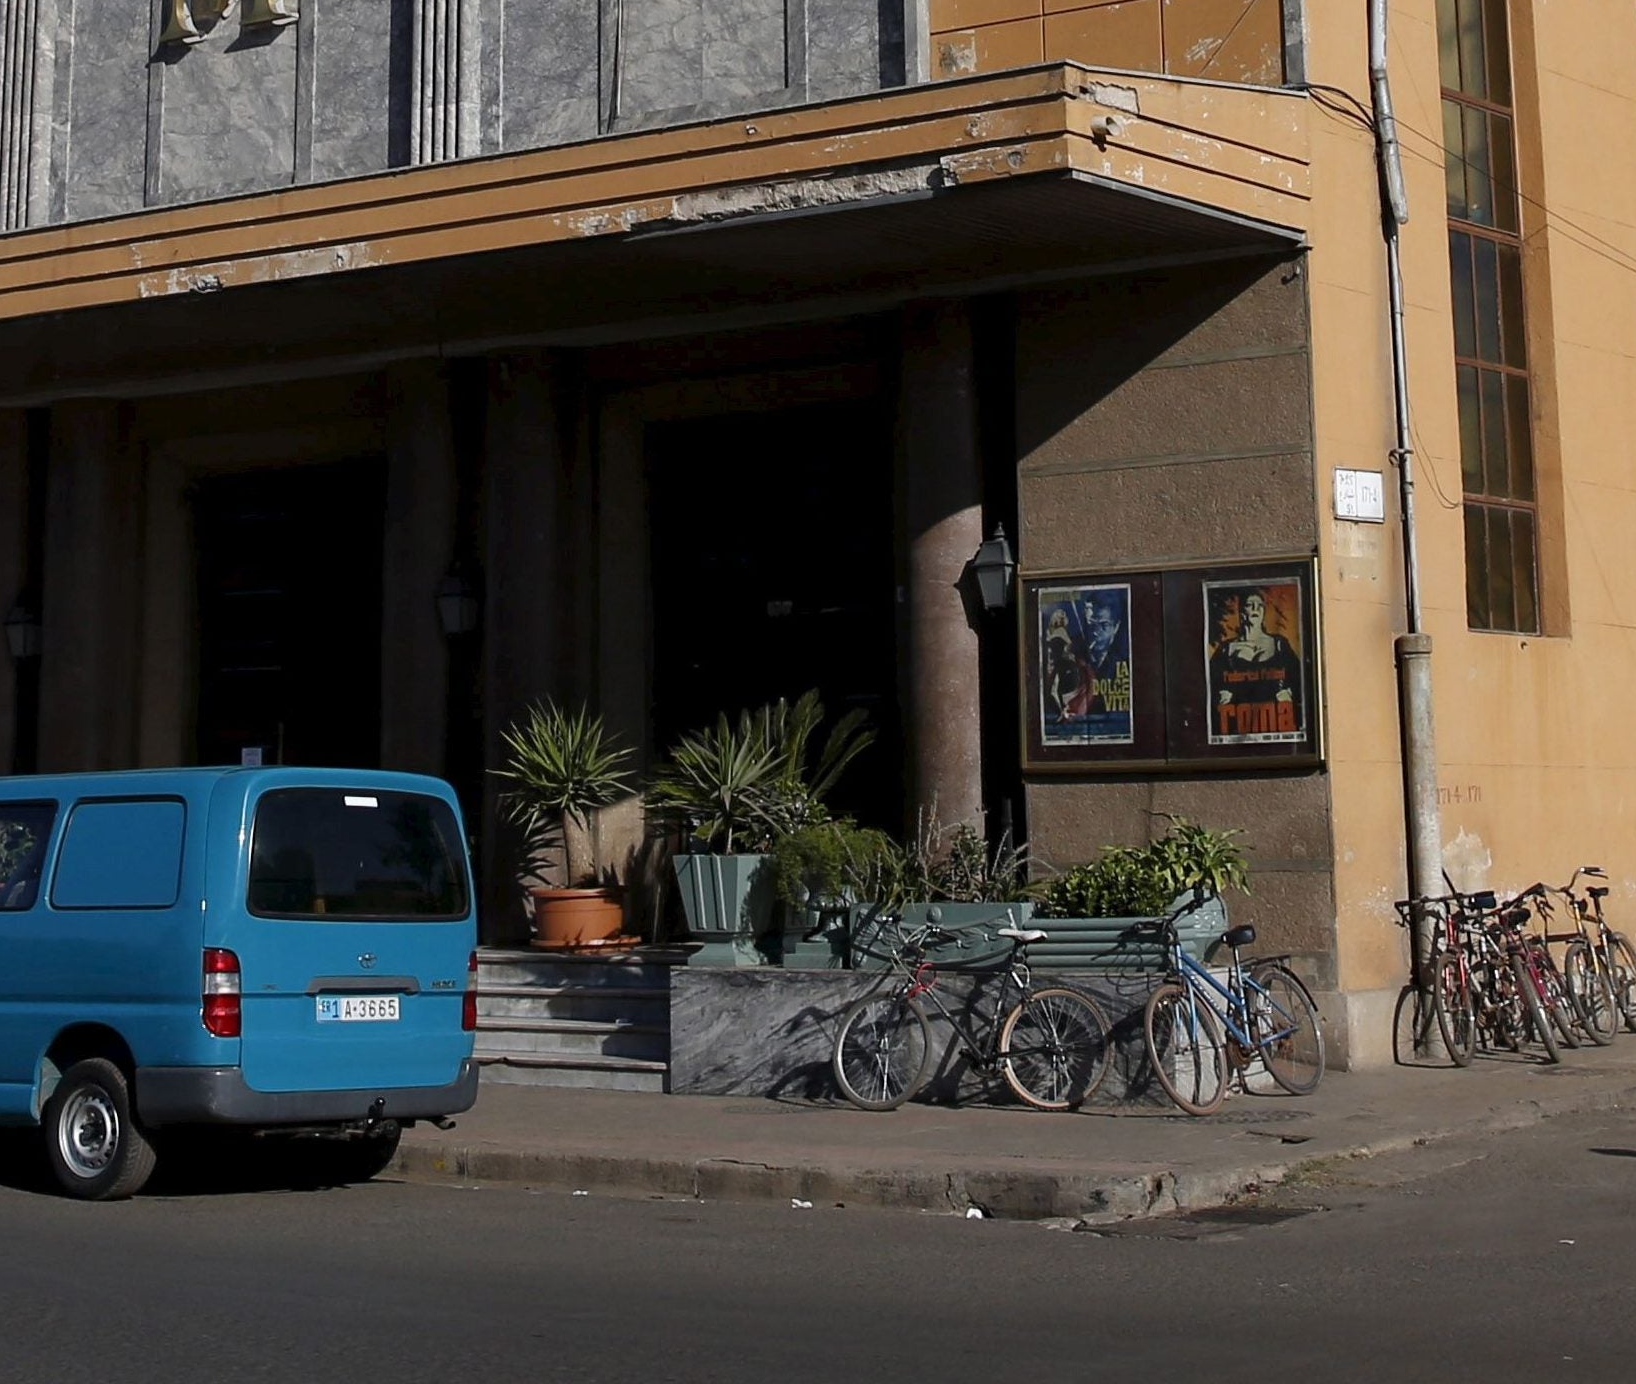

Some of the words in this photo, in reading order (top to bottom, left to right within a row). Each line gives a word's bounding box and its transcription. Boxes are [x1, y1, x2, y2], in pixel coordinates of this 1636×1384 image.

[1116, 661, 1129, 678] LA
[1092, 678, 1130, 696] DOLCE
[1217, 700, 1296, 735] roma
